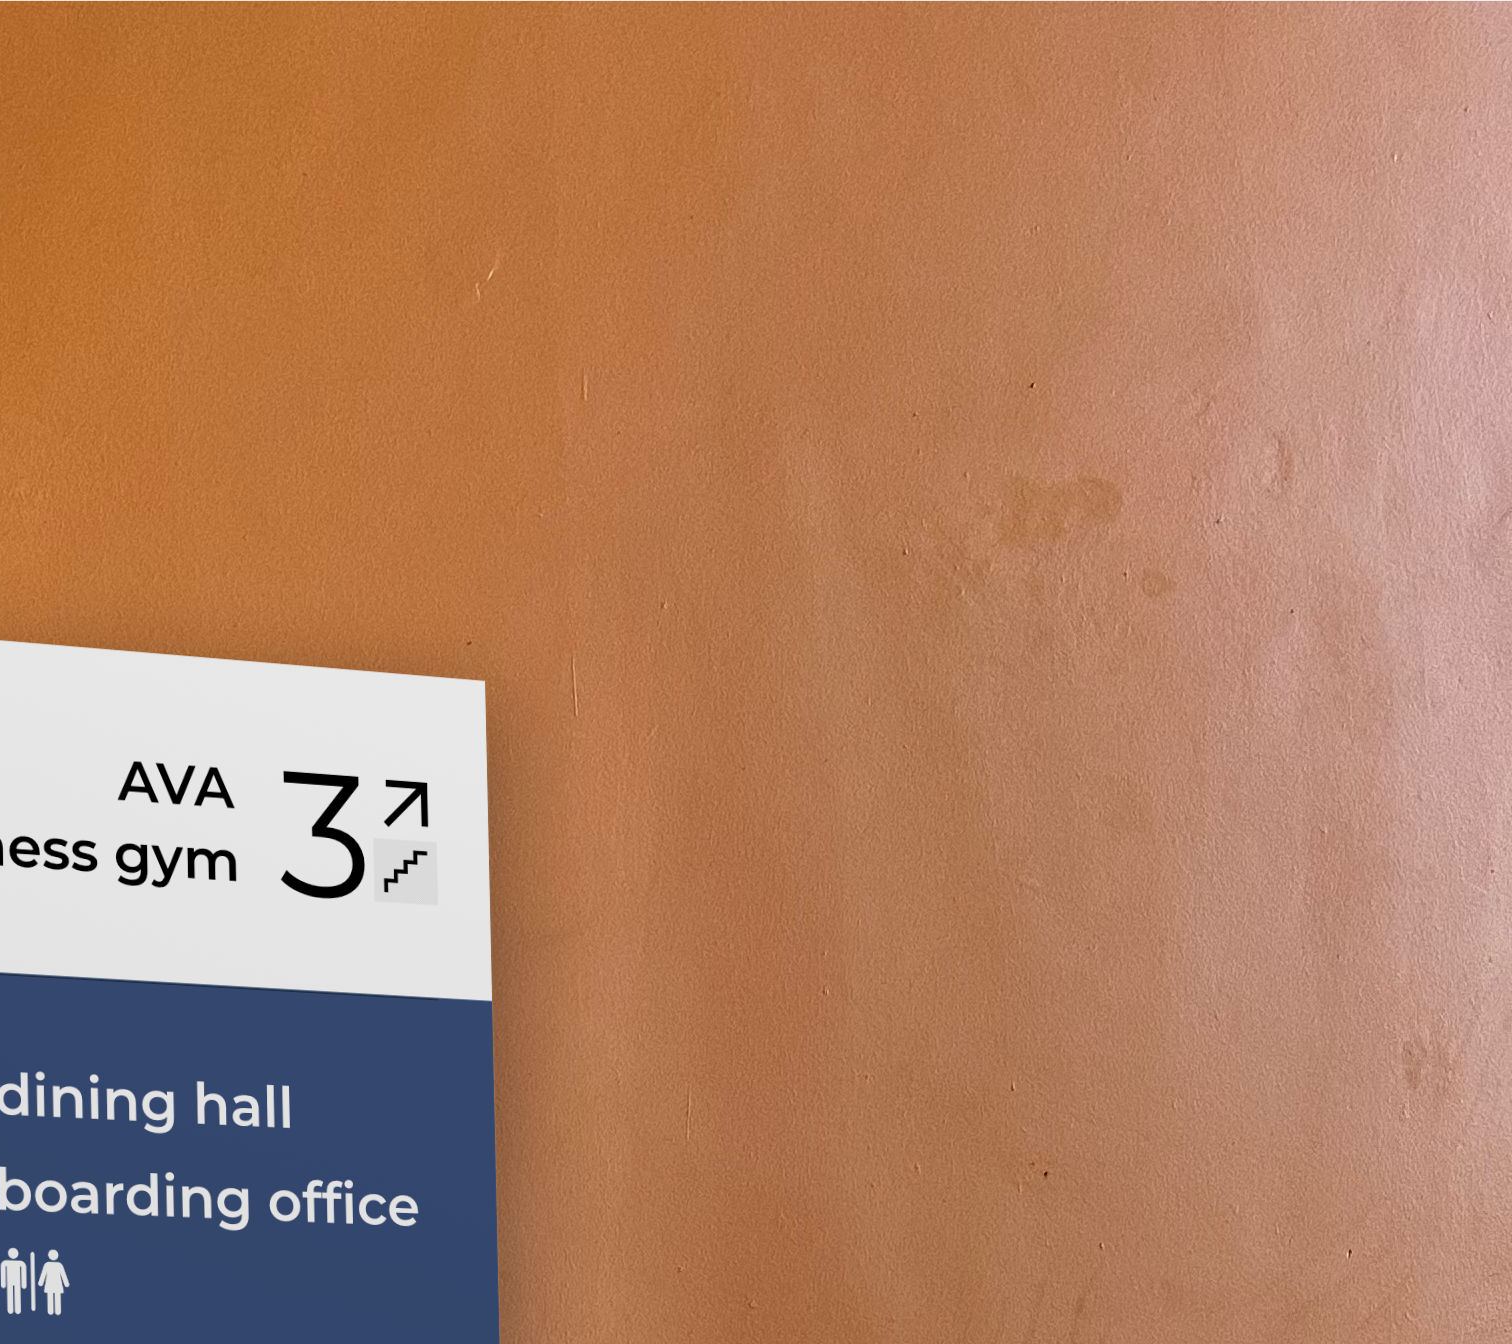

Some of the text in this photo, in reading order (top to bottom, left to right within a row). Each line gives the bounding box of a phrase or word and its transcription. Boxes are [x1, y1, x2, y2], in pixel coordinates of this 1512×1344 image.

[118, 762, 235, 808] AVA
[281, 771, 366, 899] 3
[115, 844, 237, 887] gym
[196, 1080, 291, 1129] hall
[269, 1179, 419, 1227] office
